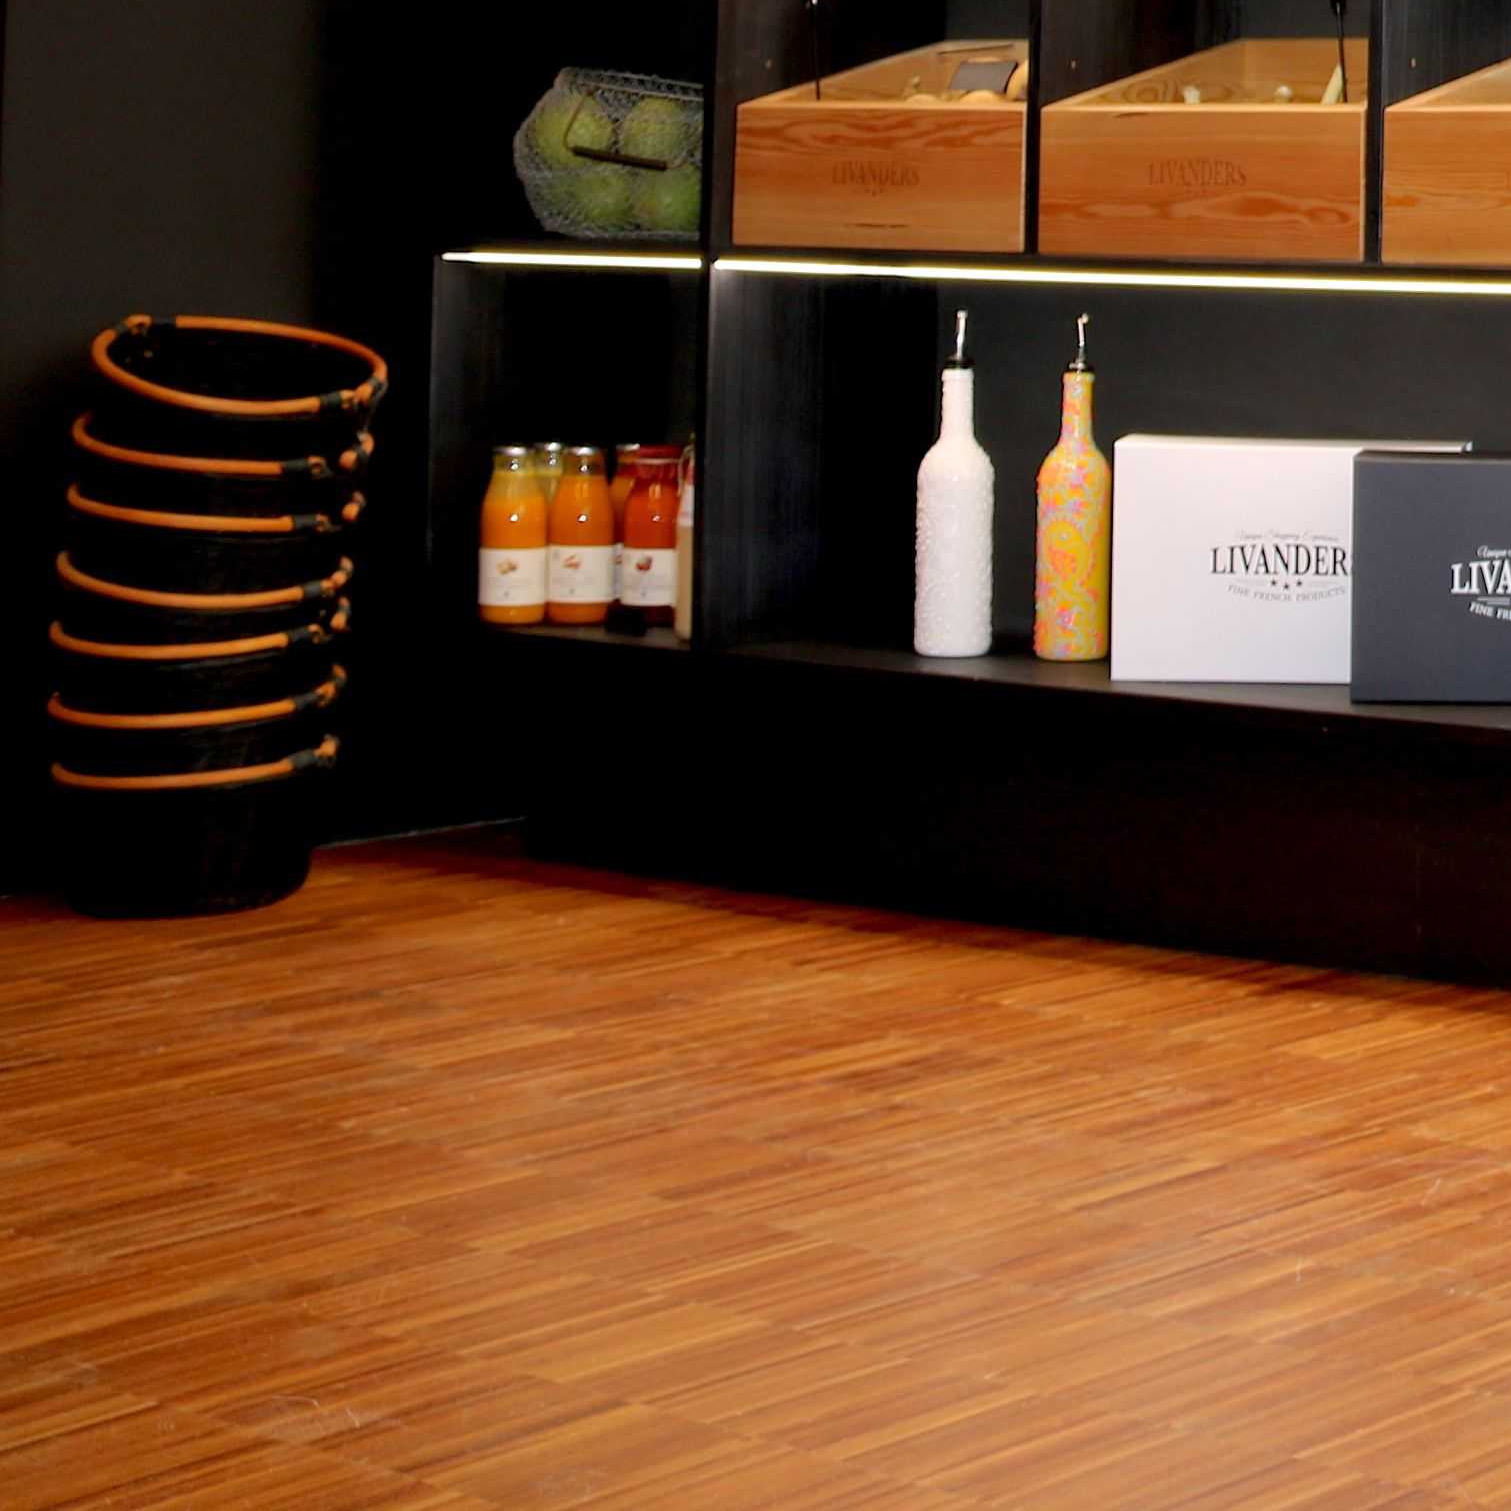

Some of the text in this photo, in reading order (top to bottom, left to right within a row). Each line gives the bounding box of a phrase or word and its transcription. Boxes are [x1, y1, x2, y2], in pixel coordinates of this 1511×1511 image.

[832, 161, 919, 187] LIVANDERS
[1148, 160, 1247, 187] LIVANDERS
[1211, 543, 1349, 576] LIVANDER
[1469, 602, 1494, 617] FINE
